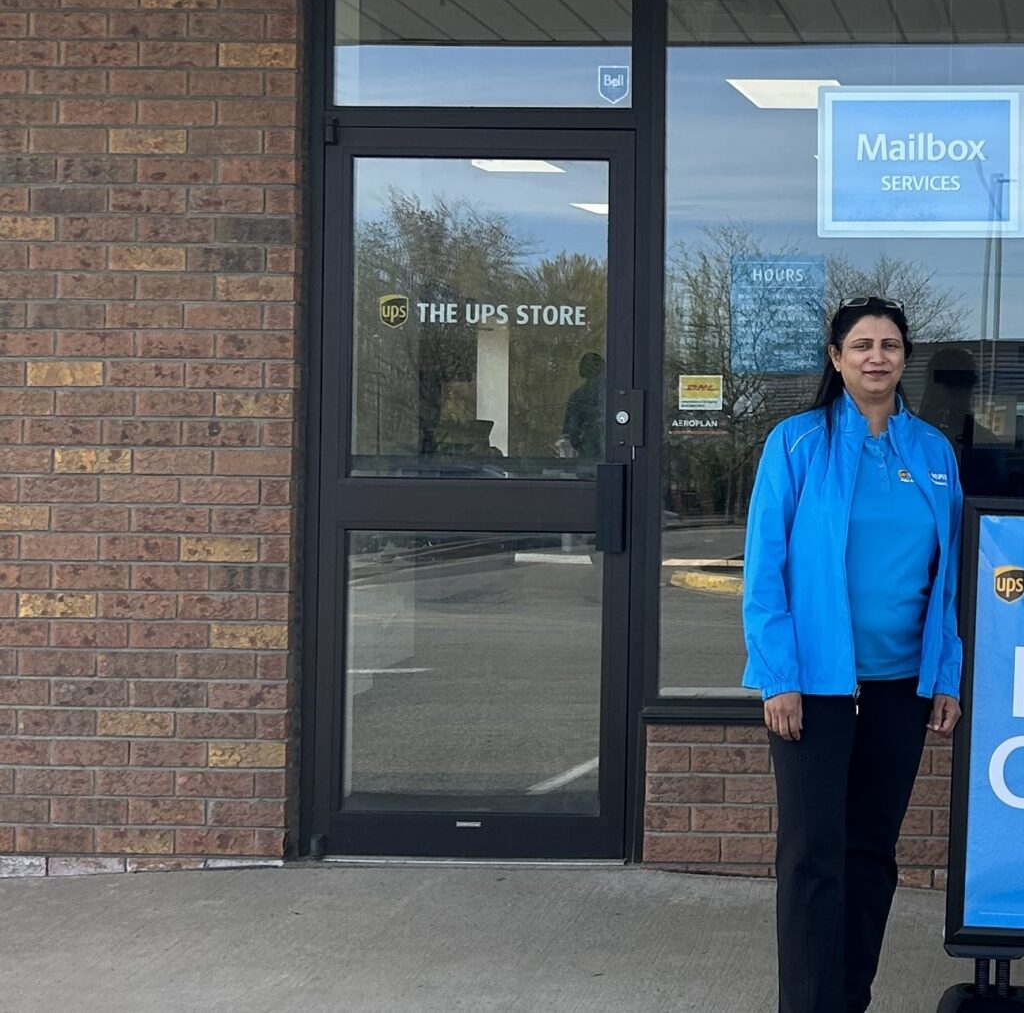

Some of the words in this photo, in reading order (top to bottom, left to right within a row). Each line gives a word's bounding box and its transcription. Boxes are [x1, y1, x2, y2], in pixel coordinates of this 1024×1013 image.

[603, 74, 624, 87] Bell
[856, 132, 986, 162] Mailbox
[881, 175, 961, 191] SERVICES
[752, 268, 804, 282] HOURS
[381, 304, 406, 323] ups
[417, 302, 458, 324] THE
[465, 303, 509, 325] UPS
[516, 304, 586, 326] STORE
[672, 419, 718, 427] AEROPLAN
[995, 576, 1024, 598] ups
